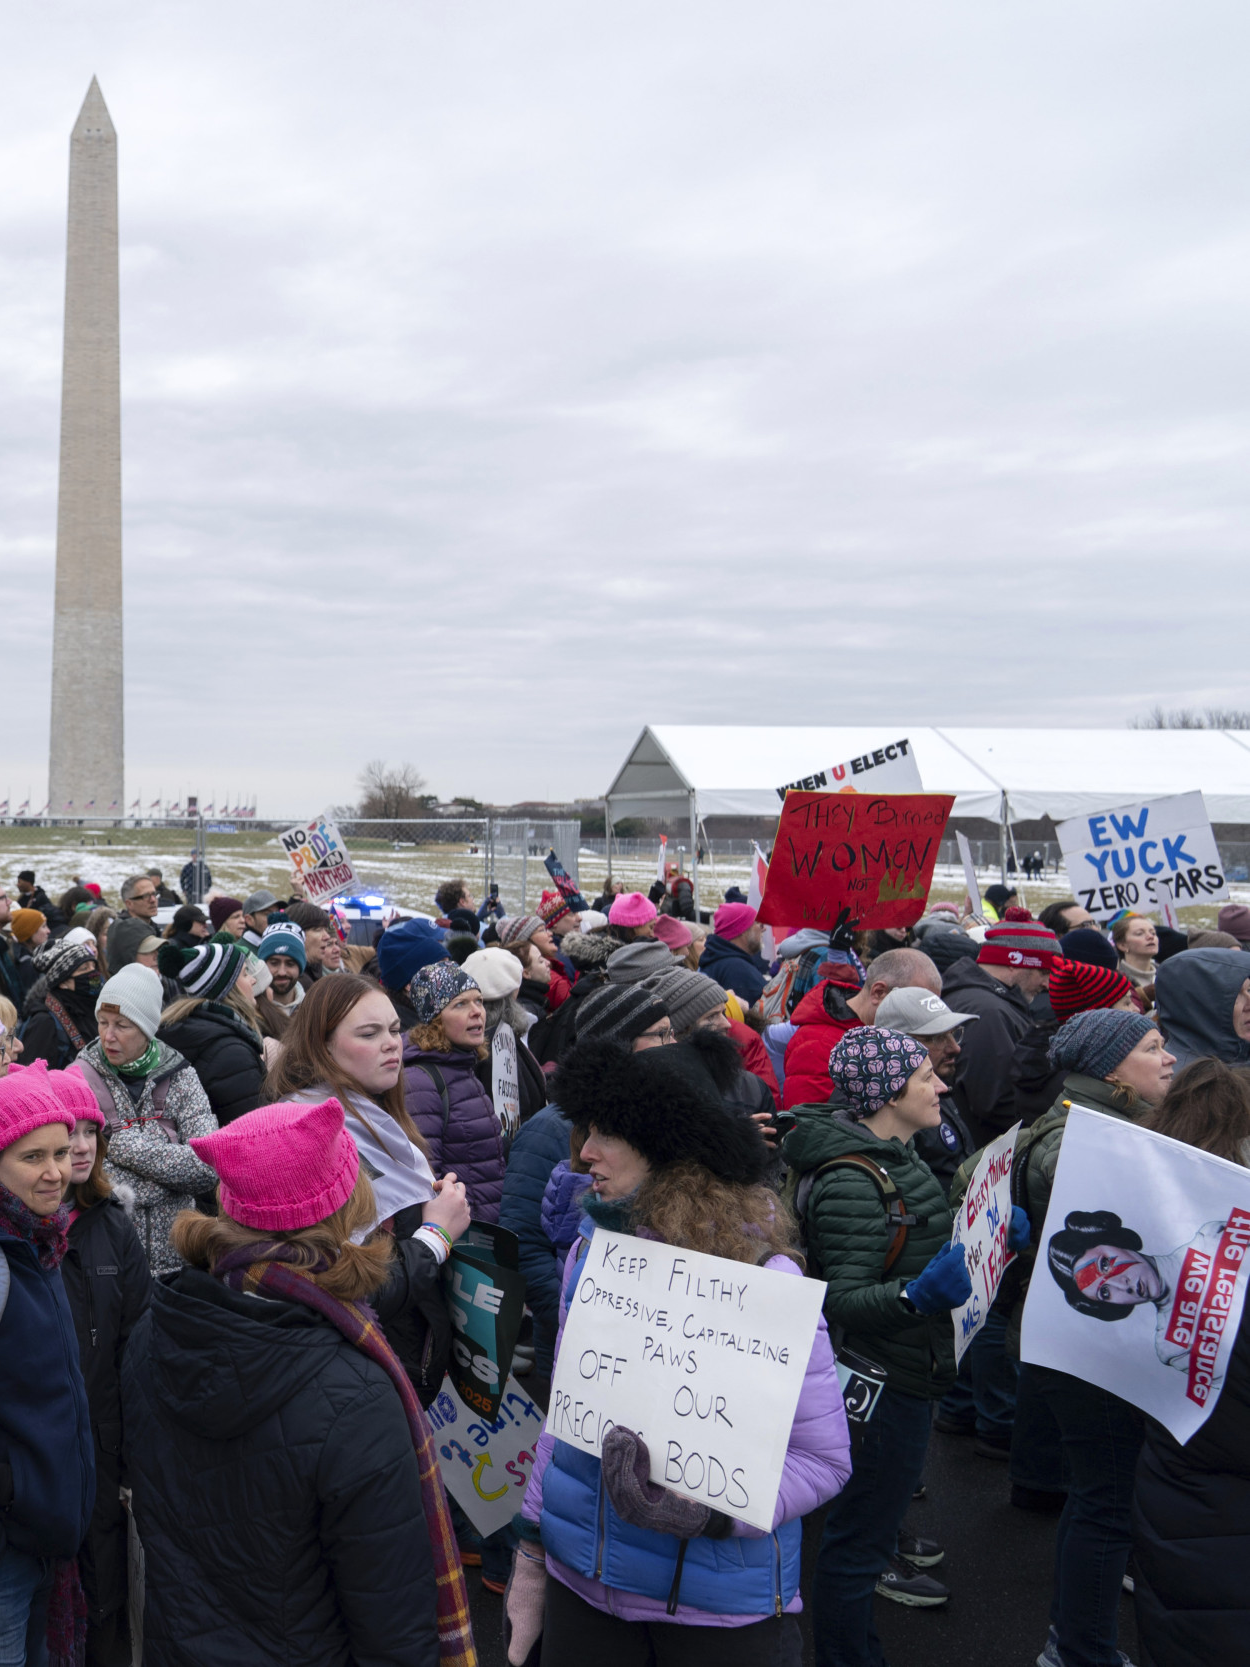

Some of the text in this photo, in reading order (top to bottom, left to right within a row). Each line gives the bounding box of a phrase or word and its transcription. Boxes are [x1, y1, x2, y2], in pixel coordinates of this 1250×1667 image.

[831, 763, 846, 781] U
[850, 739, 909, 775] ELECT
[790, 796, 855, 834] THEY
[1088, 807, 1149, 847] EW
[282, 830, 307, 852] NO
[788, 836, 933, 879] WOMEN
[1084, 834, 1197, 883] YUCK
[303, 863, 353, 898] APARTHEID
[847, 877, 876, 892] NOT
[1078, 865, 1224, 913] ZERO STARS
[602, 1242, 748, 1312] KEEP FILTHY,
[579, 1277, 790, 1366] OPPRESSIVE, CAPITALIZING
[961, 1294, 981, 1339] WAS
[642, 1336, 698, 1374] PAWS
[579, 1349, 734, 1428] OFF OUR
[552, 1389, 750, 1509] PRECIO BODS
